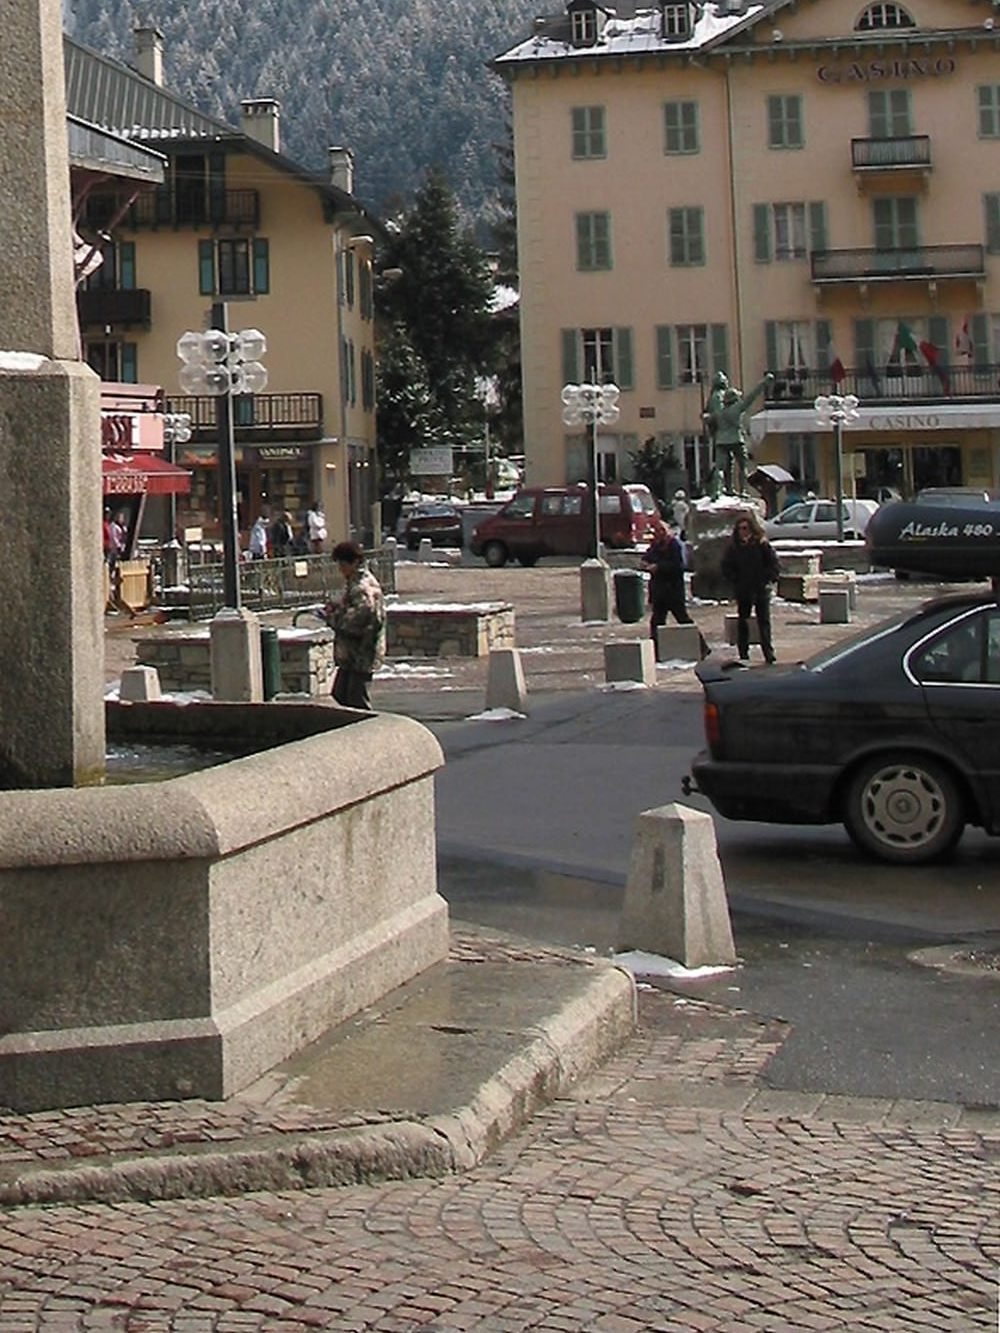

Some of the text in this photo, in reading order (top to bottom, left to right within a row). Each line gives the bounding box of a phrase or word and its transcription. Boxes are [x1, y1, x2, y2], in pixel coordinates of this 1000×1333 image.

[815, 57, 956, 83] CASINO
[869, 414, 941, 429] CASINO
[899, 521, 993, 540] Alaska 480
